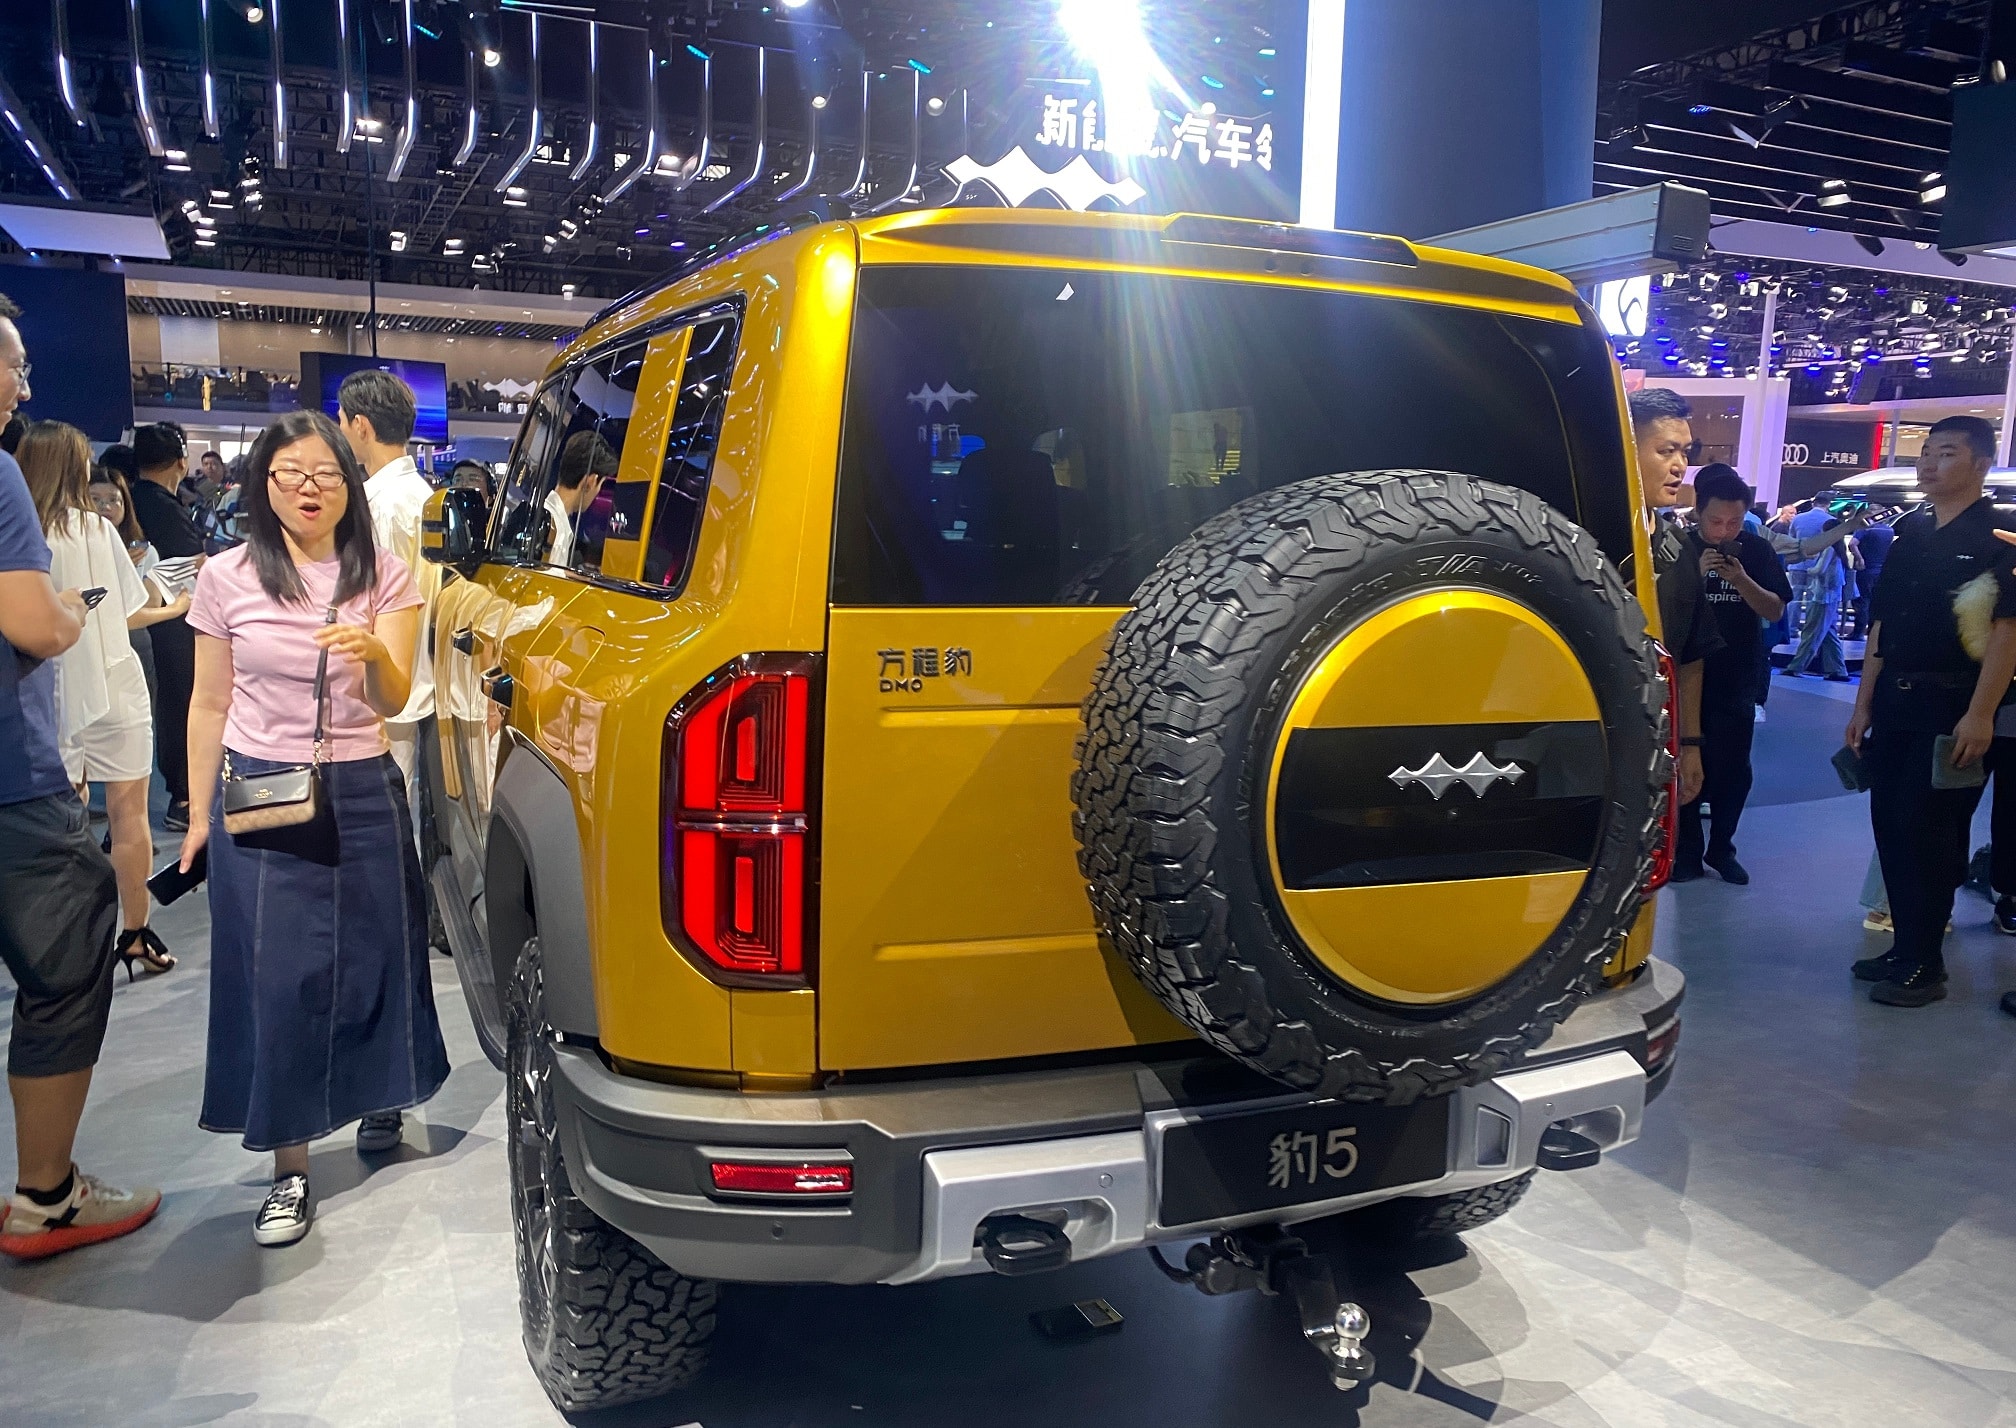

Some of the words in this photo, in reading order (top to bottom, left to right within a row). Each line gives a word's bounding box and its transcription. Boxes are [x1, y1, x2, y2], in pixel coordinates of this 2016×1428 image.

[1820, 451, 1859, 465] 上汽奥迪
[879, 678, 923, 693] DMO
[1267, 1126, 1359, 1189] 豹5
